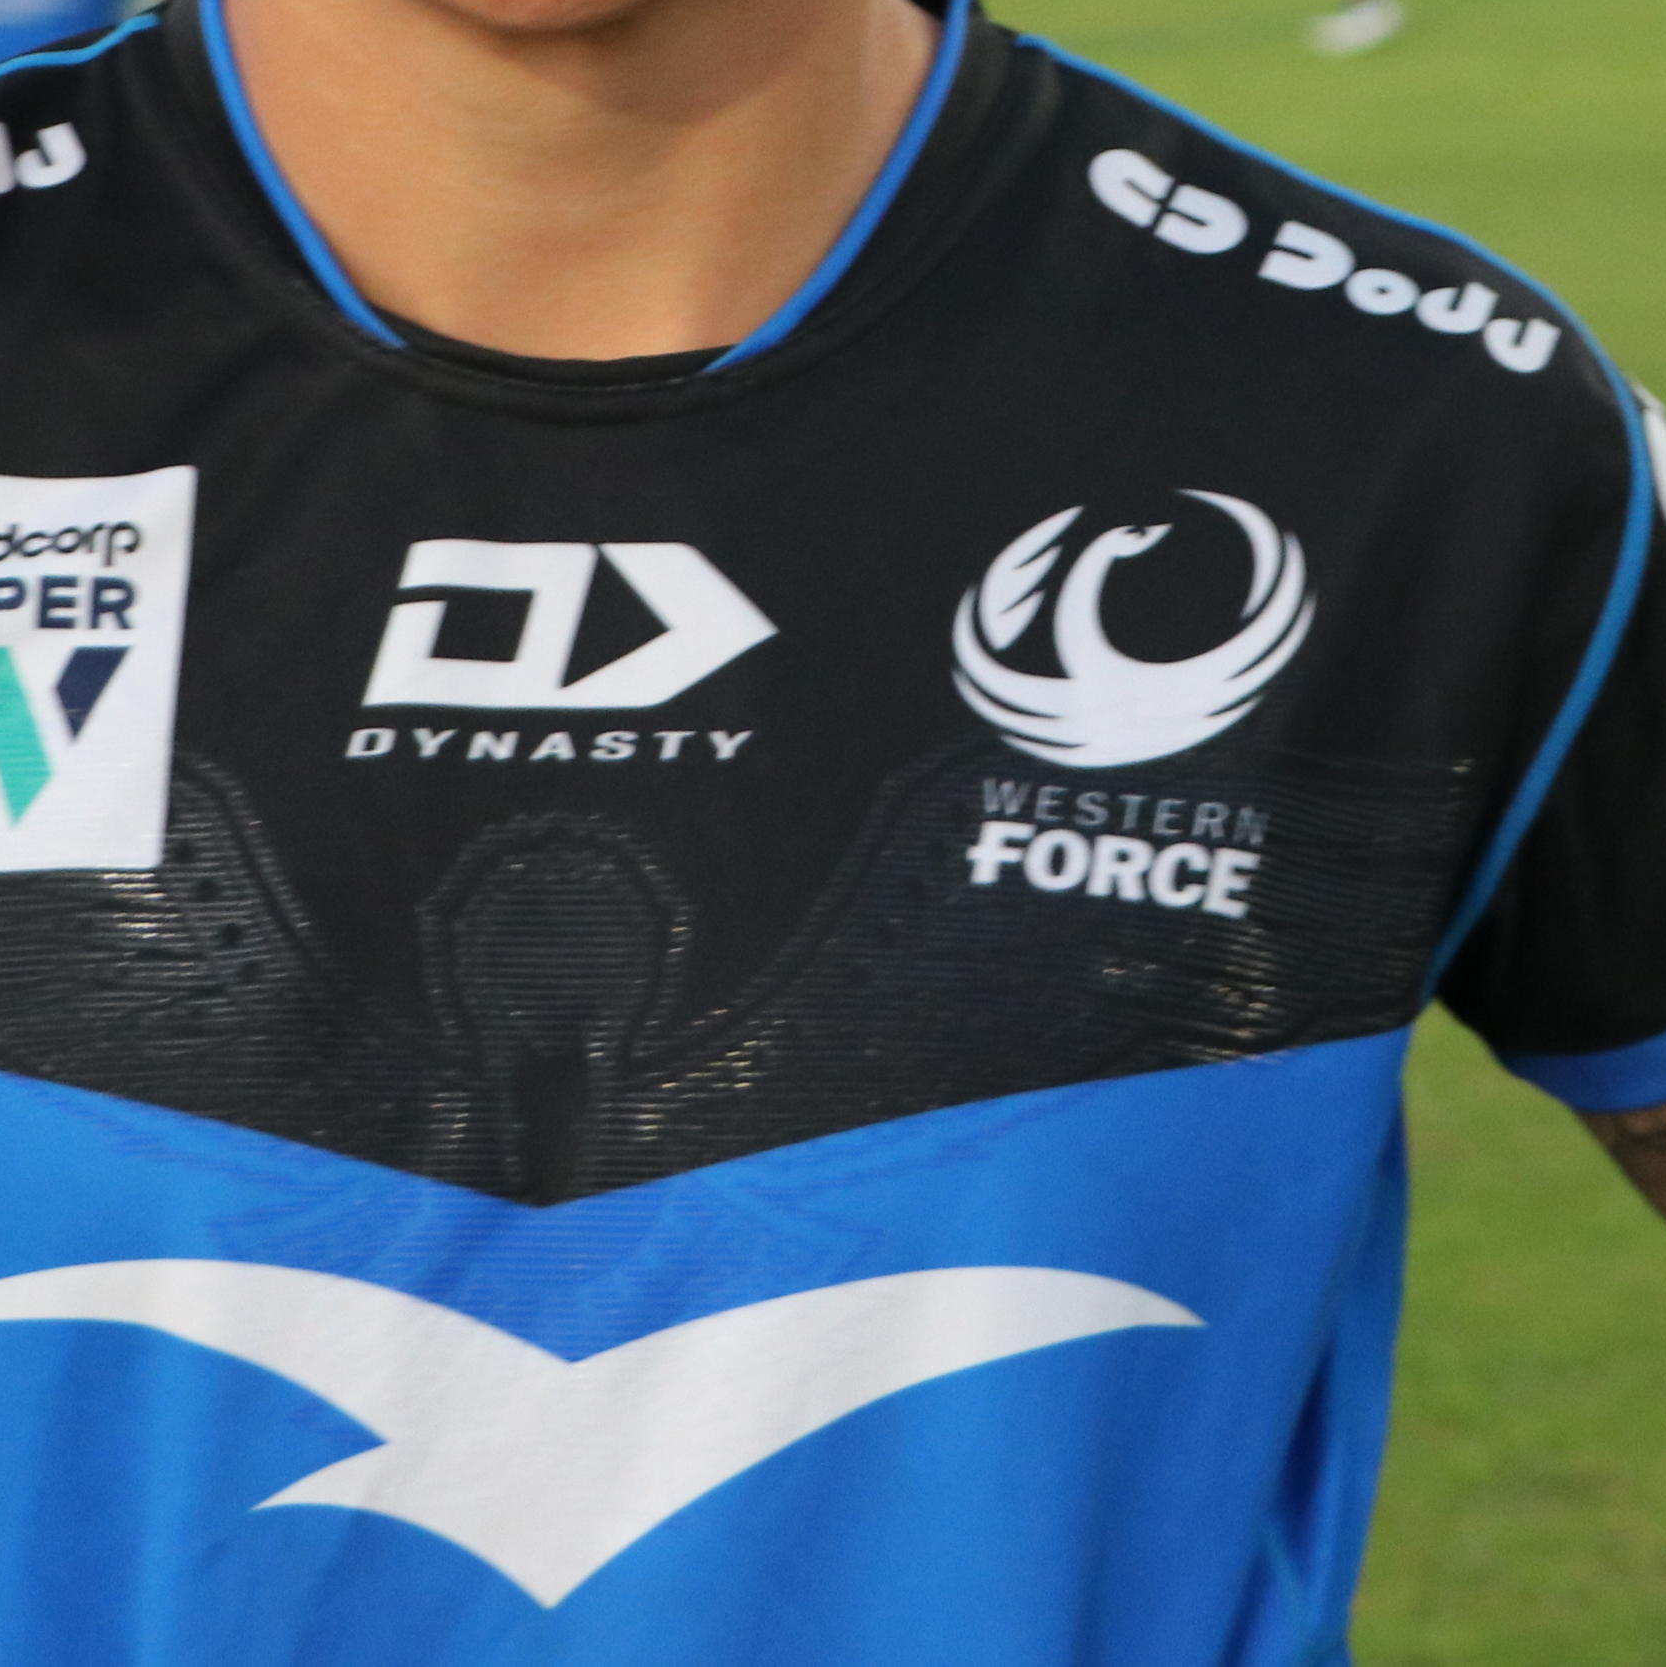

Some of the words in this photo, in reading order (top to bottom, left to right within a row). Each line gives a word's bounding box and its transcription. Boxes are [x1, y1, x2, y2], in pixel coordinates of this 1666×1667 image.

[344, 727, 755, 762] DYNASTY
[979, 777, 1270, 846] WESTERN
[965, 820, 1261, 921] FORCE
